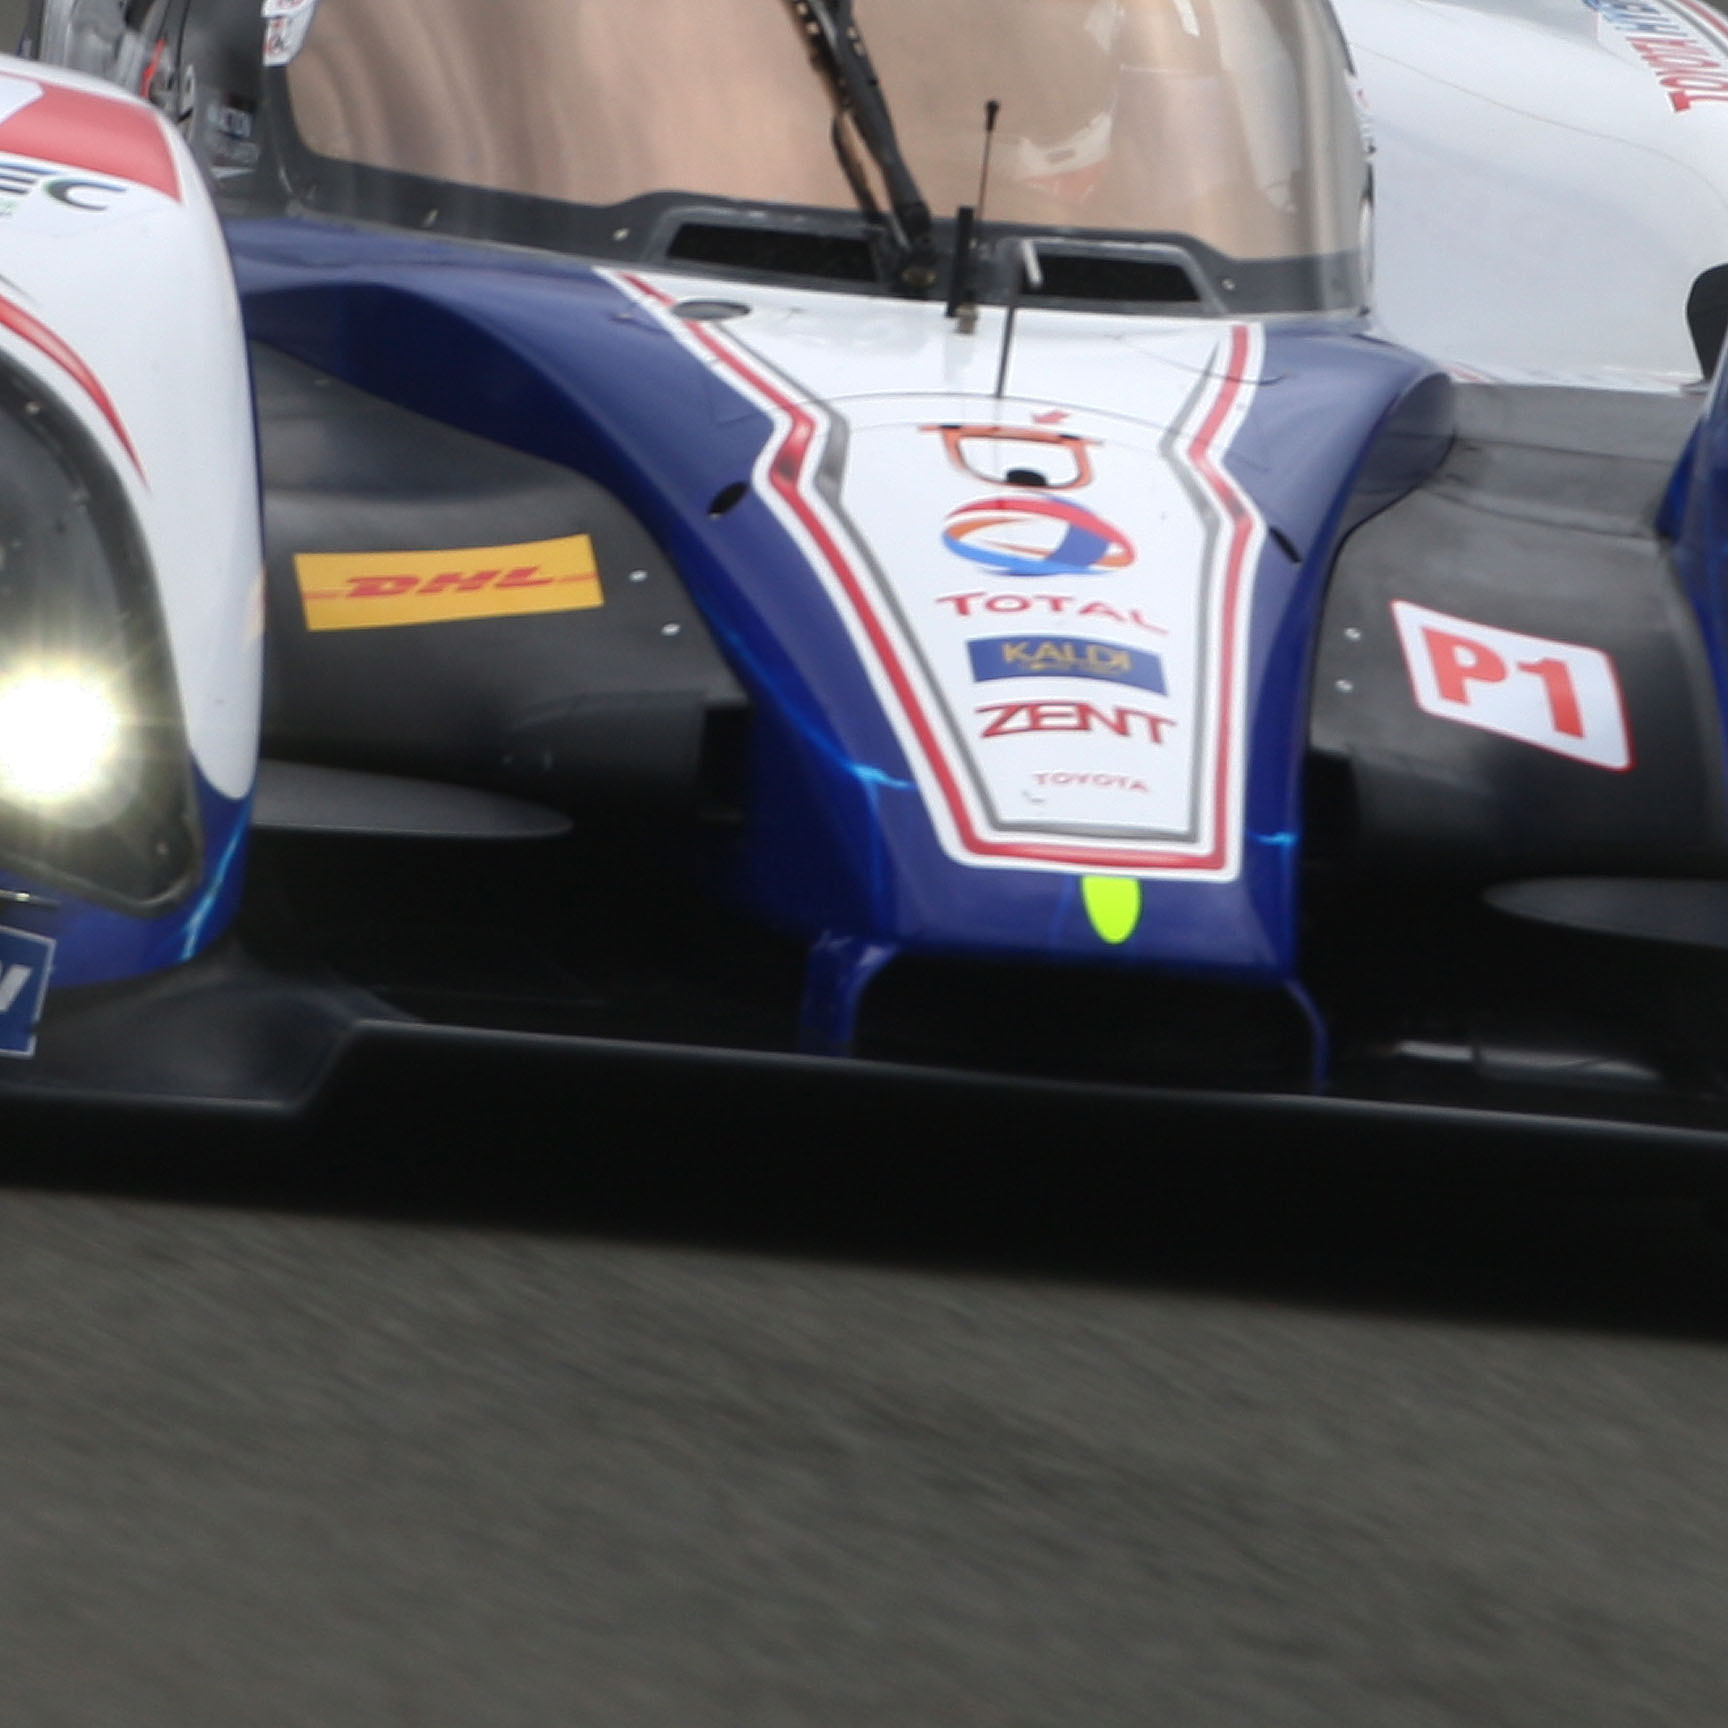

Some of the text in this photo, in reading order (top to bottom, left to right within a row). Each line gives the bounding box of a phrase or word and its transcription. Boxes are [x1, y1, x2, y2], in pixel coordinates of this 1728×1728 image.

[345, 565, 556, 599] DHL
[935, 591, 1169, 634] TOTAL
[1002, 640, 1132, 670] KALDI
[1420, 626, 1585, 739] P1
[976, 701, 1177, 746] ZENT
[1034, 772, 1150, 793] TOYOTA
